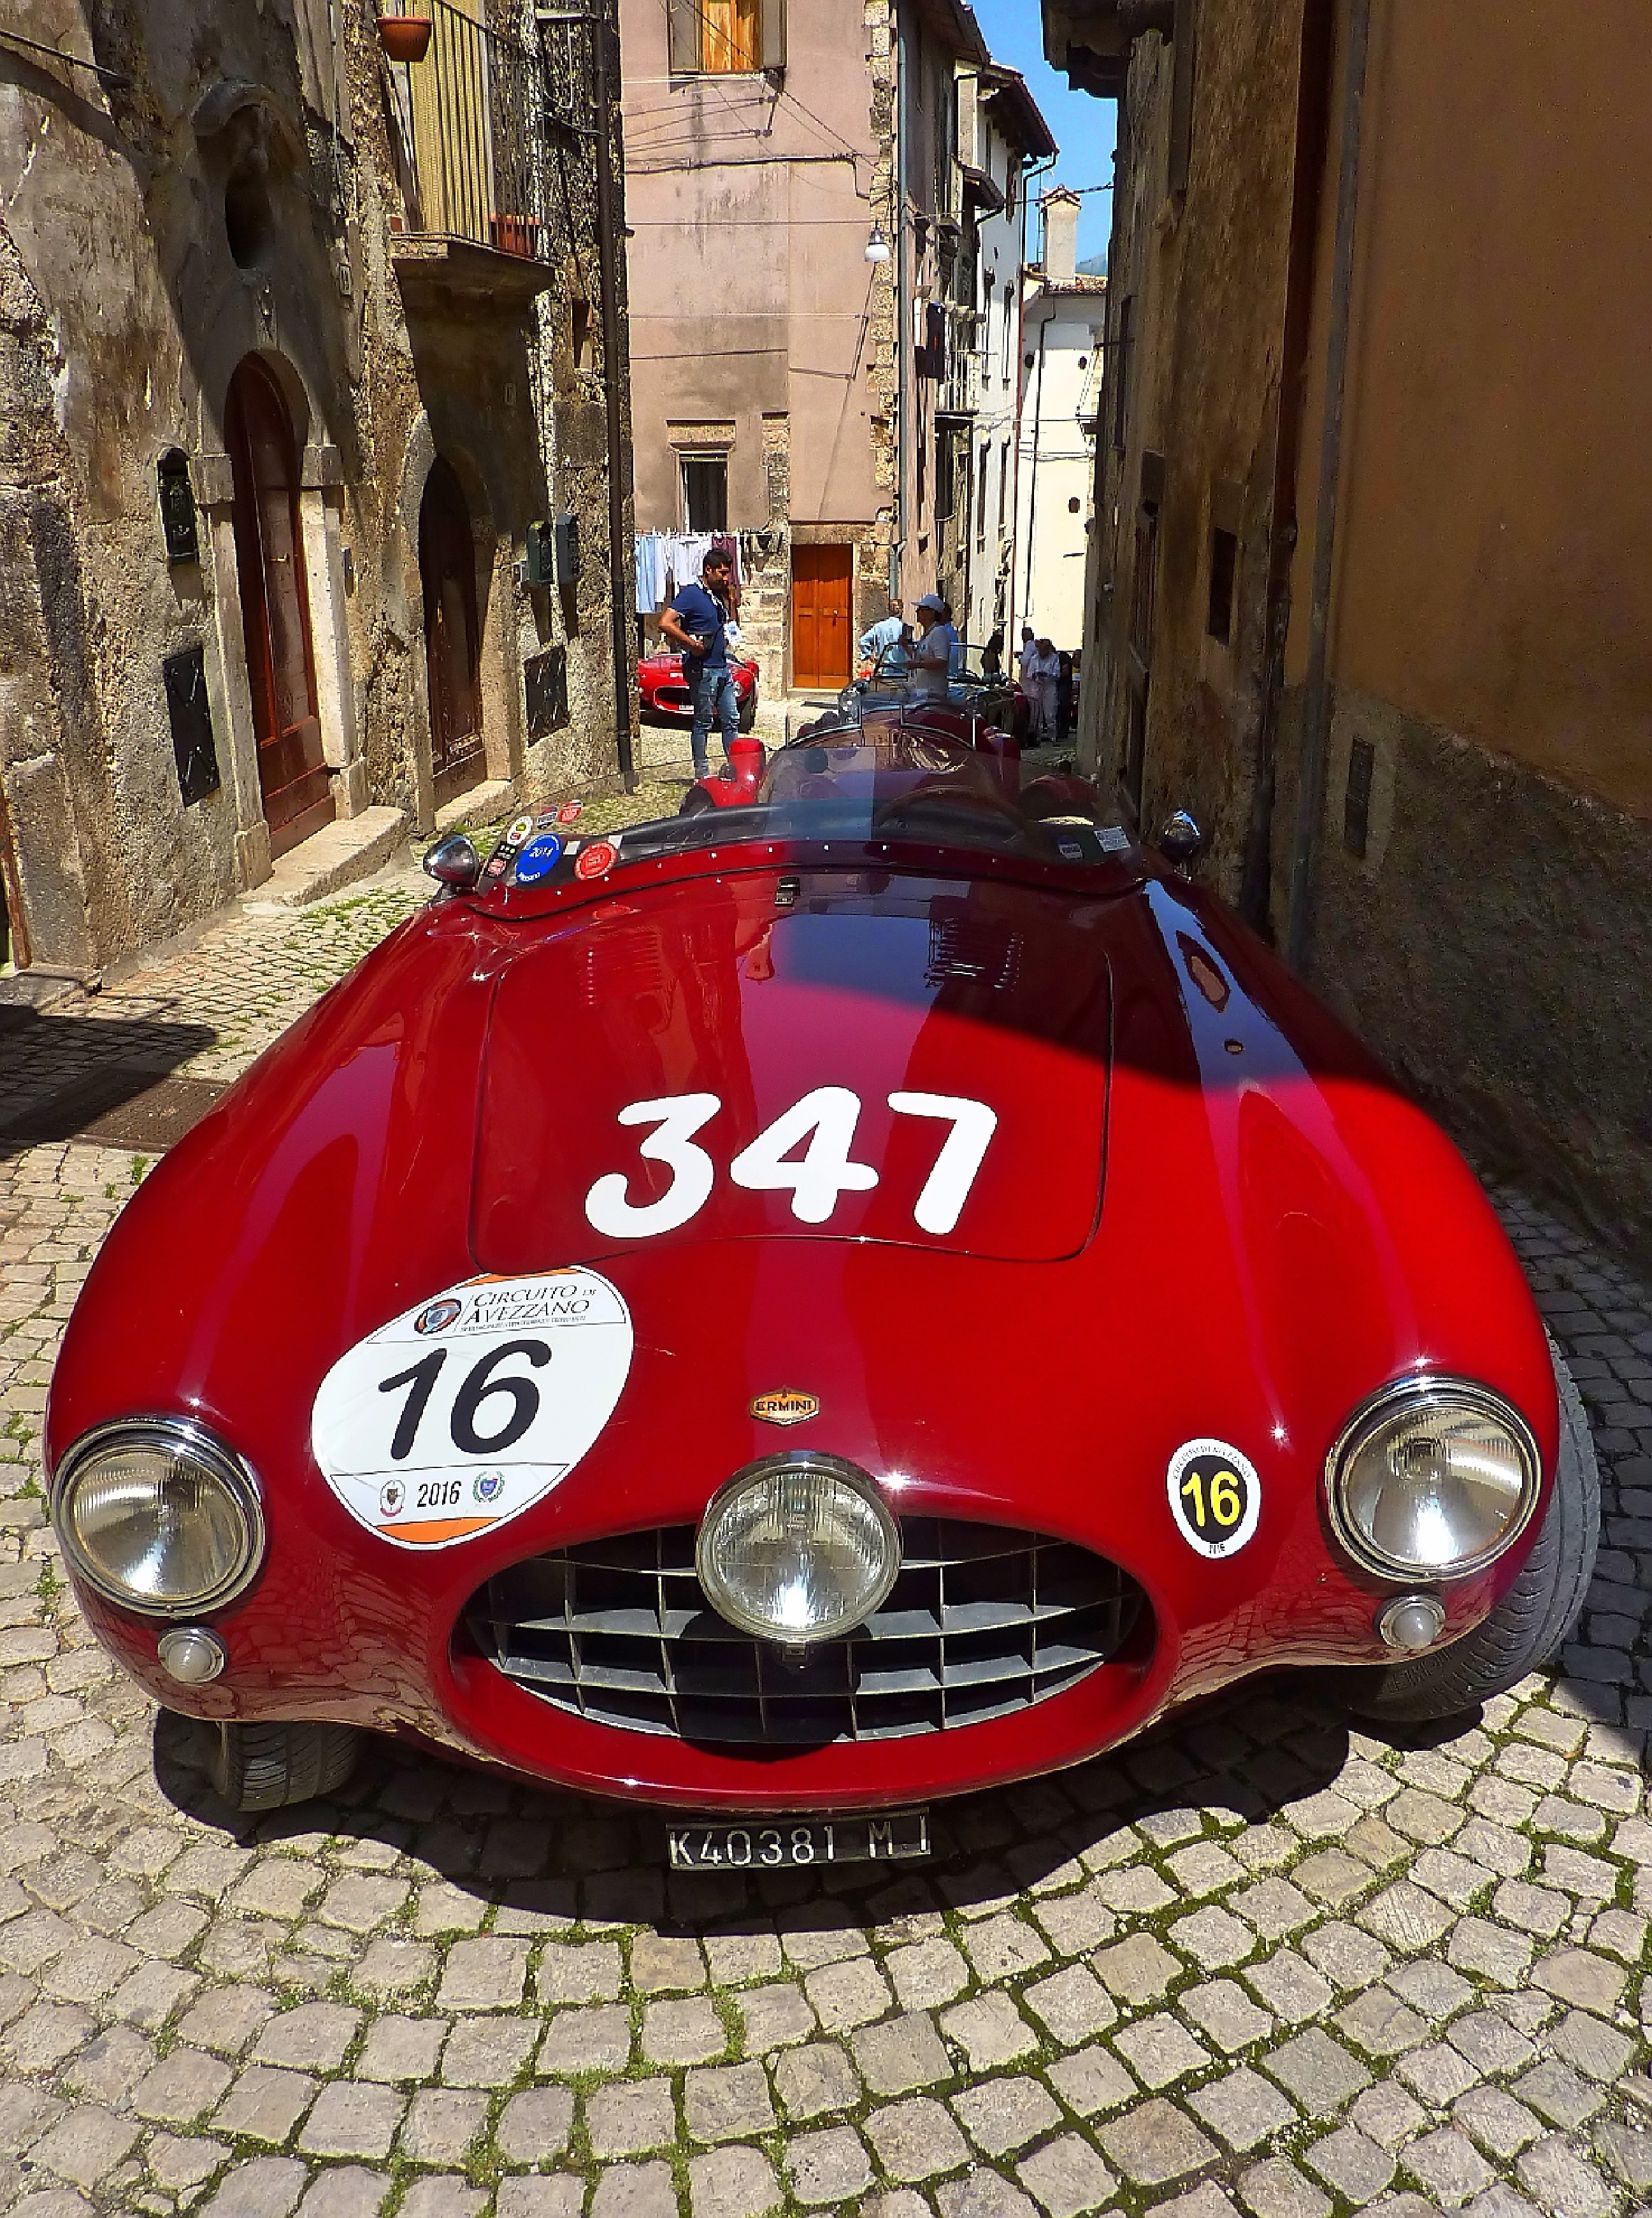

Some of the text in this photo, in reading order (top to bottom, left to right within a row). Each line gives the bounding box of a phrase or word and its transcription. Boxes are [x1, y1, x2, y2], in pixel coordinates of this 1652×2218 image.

[584, 1085, 998, 1239] 347
[464, 1299, 590, 1325] AVEZZANO
[473, 1285, 577, 1307] CIRCUITO
[378, 1339, 552, 1460] 16
[757, 1400, 812, 1411] ERMINI
[417, 1481, 462, 1508] 2016
[1181, 1471, 1240, 1527] 16
[669, 1825, 835, 1866] K40381
